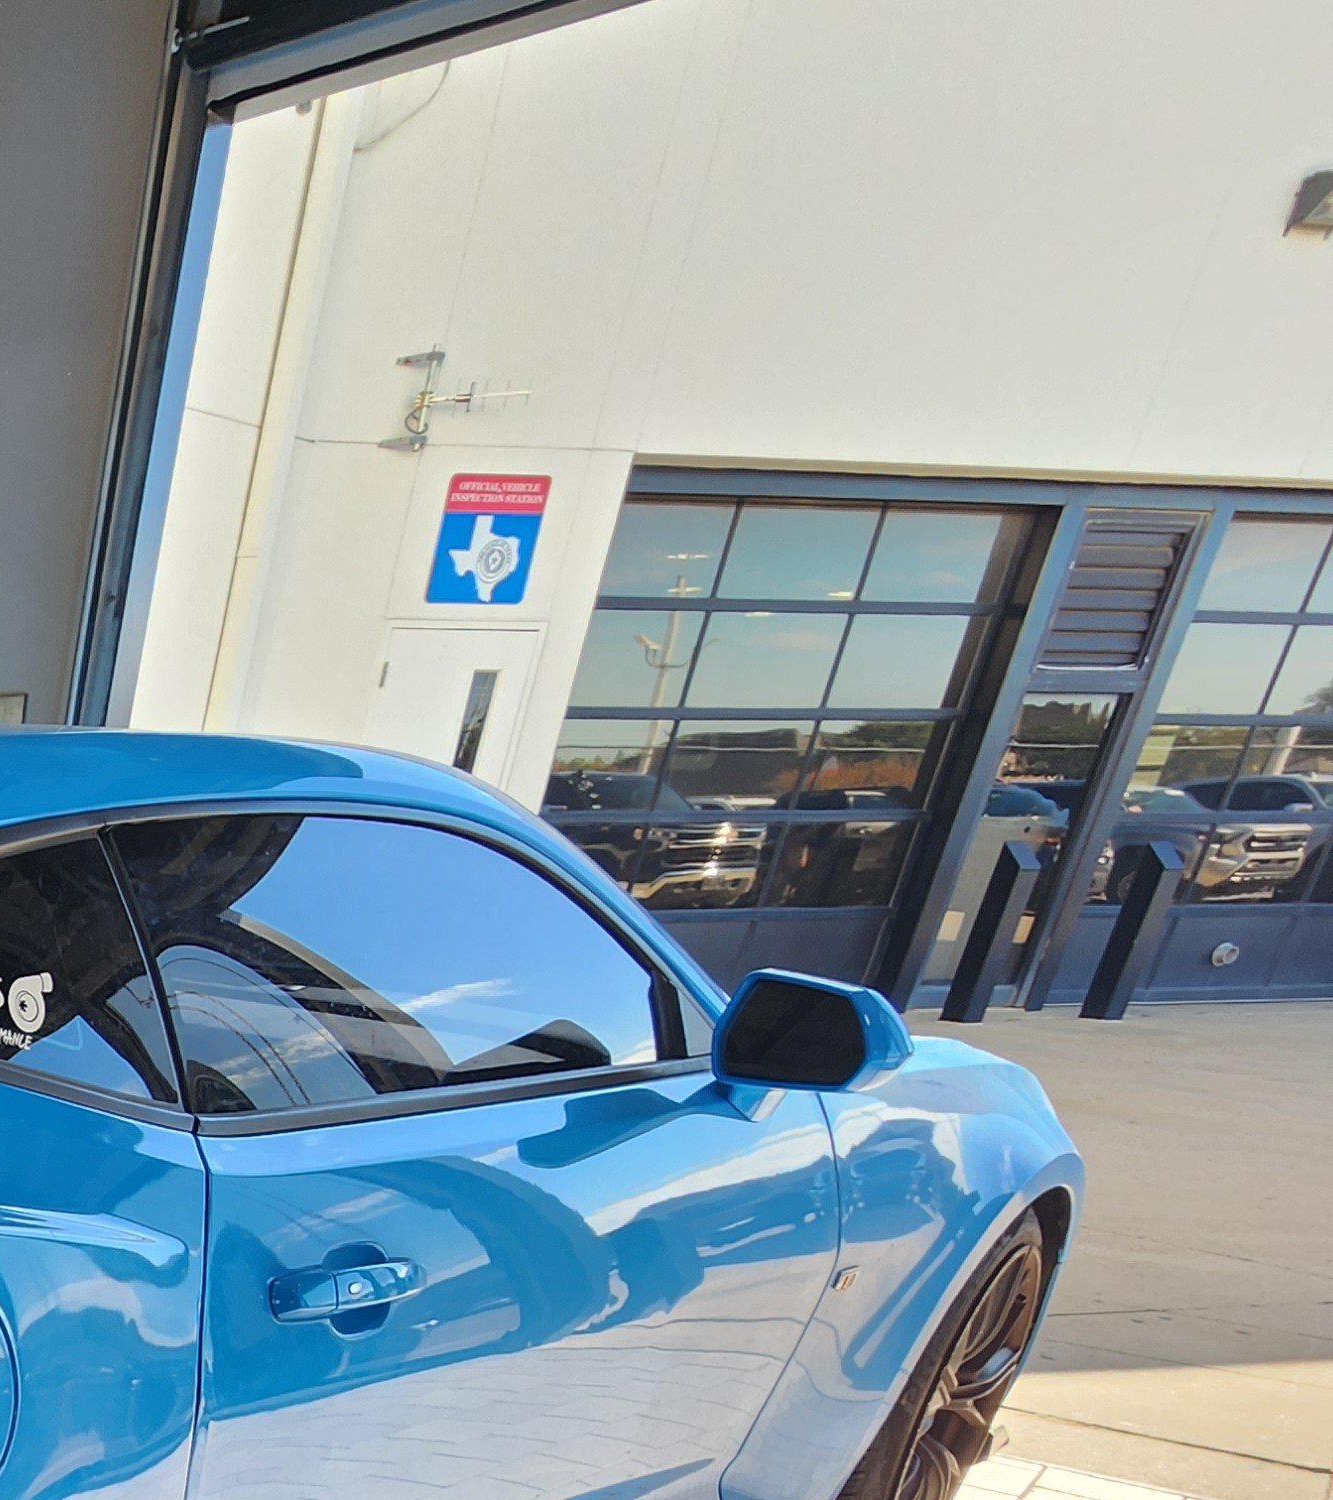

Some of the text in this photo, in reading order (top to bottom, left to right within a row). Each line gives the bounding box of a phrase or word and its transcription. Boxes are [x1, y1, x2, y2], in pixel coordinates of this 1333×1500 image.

[459, 481, 541, 492] OFFICIAL VEHICLE
[451, 492, 544, 503] INSPECTION STATION
